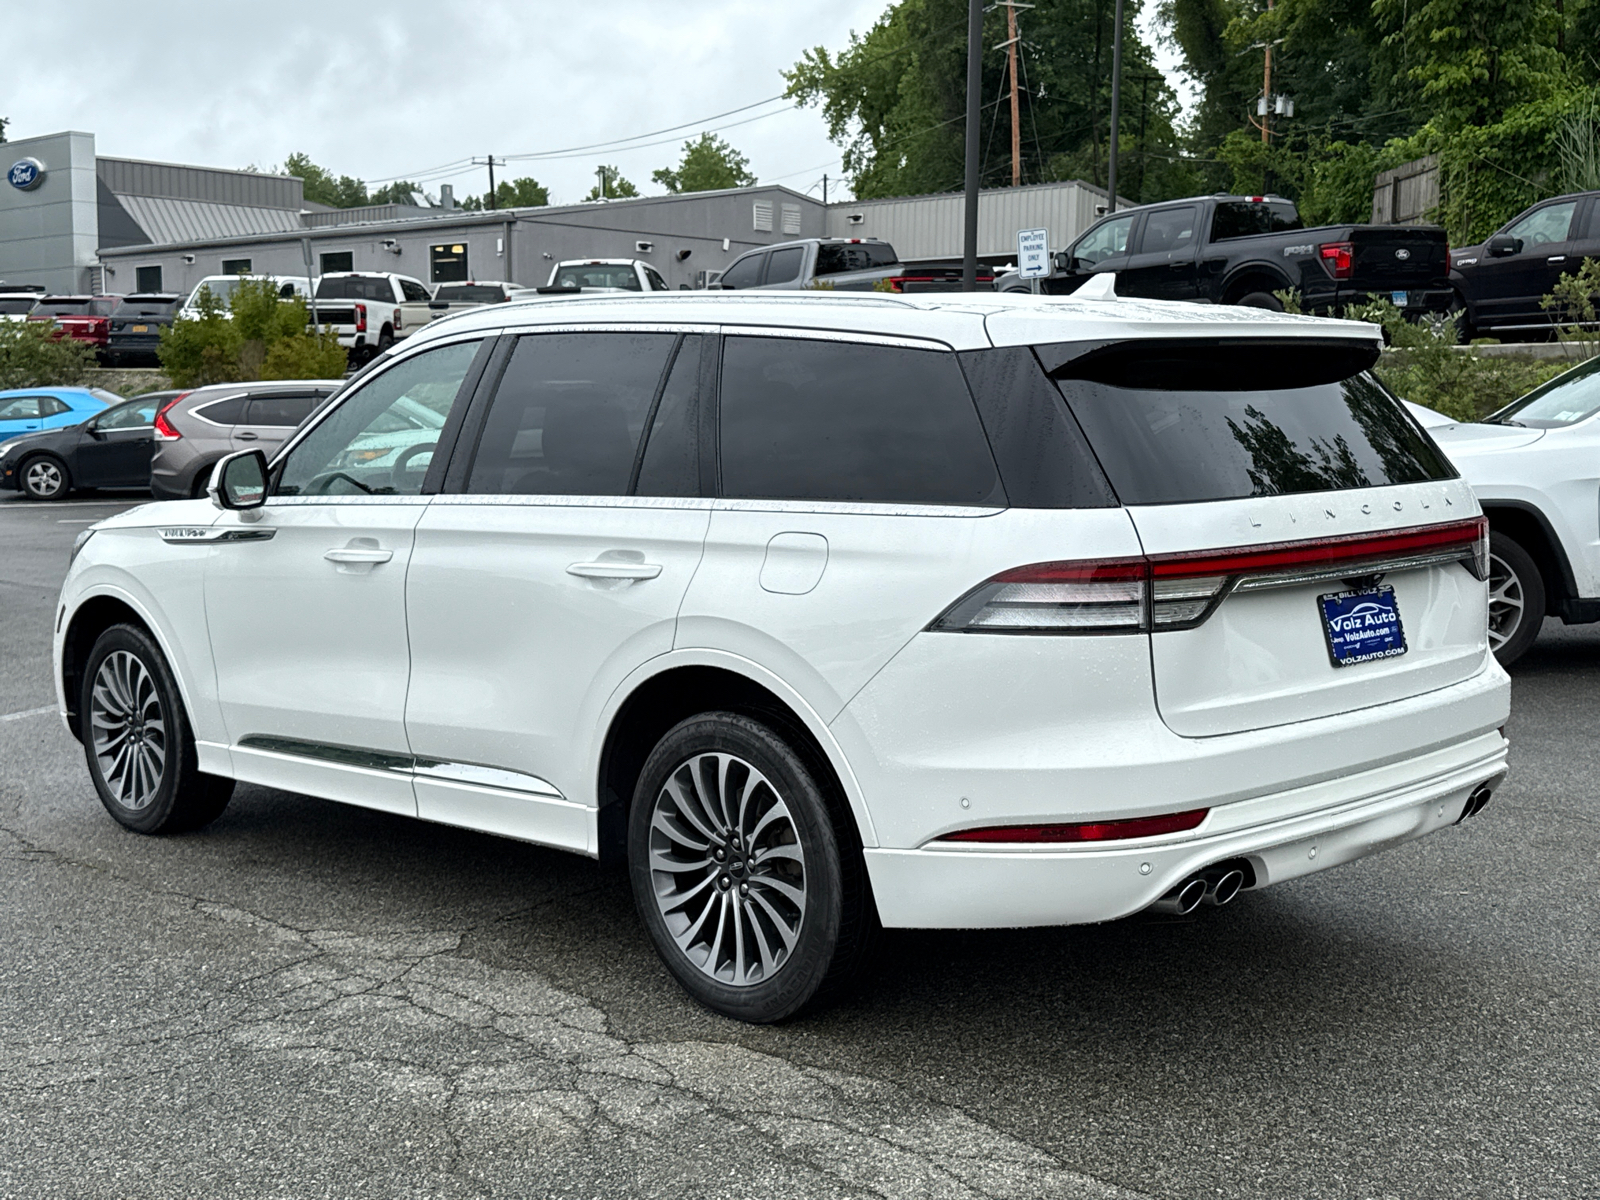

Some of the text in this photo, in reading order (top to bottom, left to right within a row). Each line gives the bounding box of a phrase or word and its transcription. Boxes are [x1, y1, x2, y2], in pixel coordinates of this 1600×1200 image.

[12, 165, 32, 184] Ford
[1021, 233, 1045, 242] EMPLOYEE
[1023, 244, 1044, 252] PARKING
[1249, 498, 1453, 528] LINCOLN
[1339, 588, 1378, 599] BILL VOLZ
[1330, 612, 1397, 632] Volz Auto
[1344, 627, 1390, 642] VolzAuto.com
[1340, 647, 1405, 665] VOLZAUTO.COM
